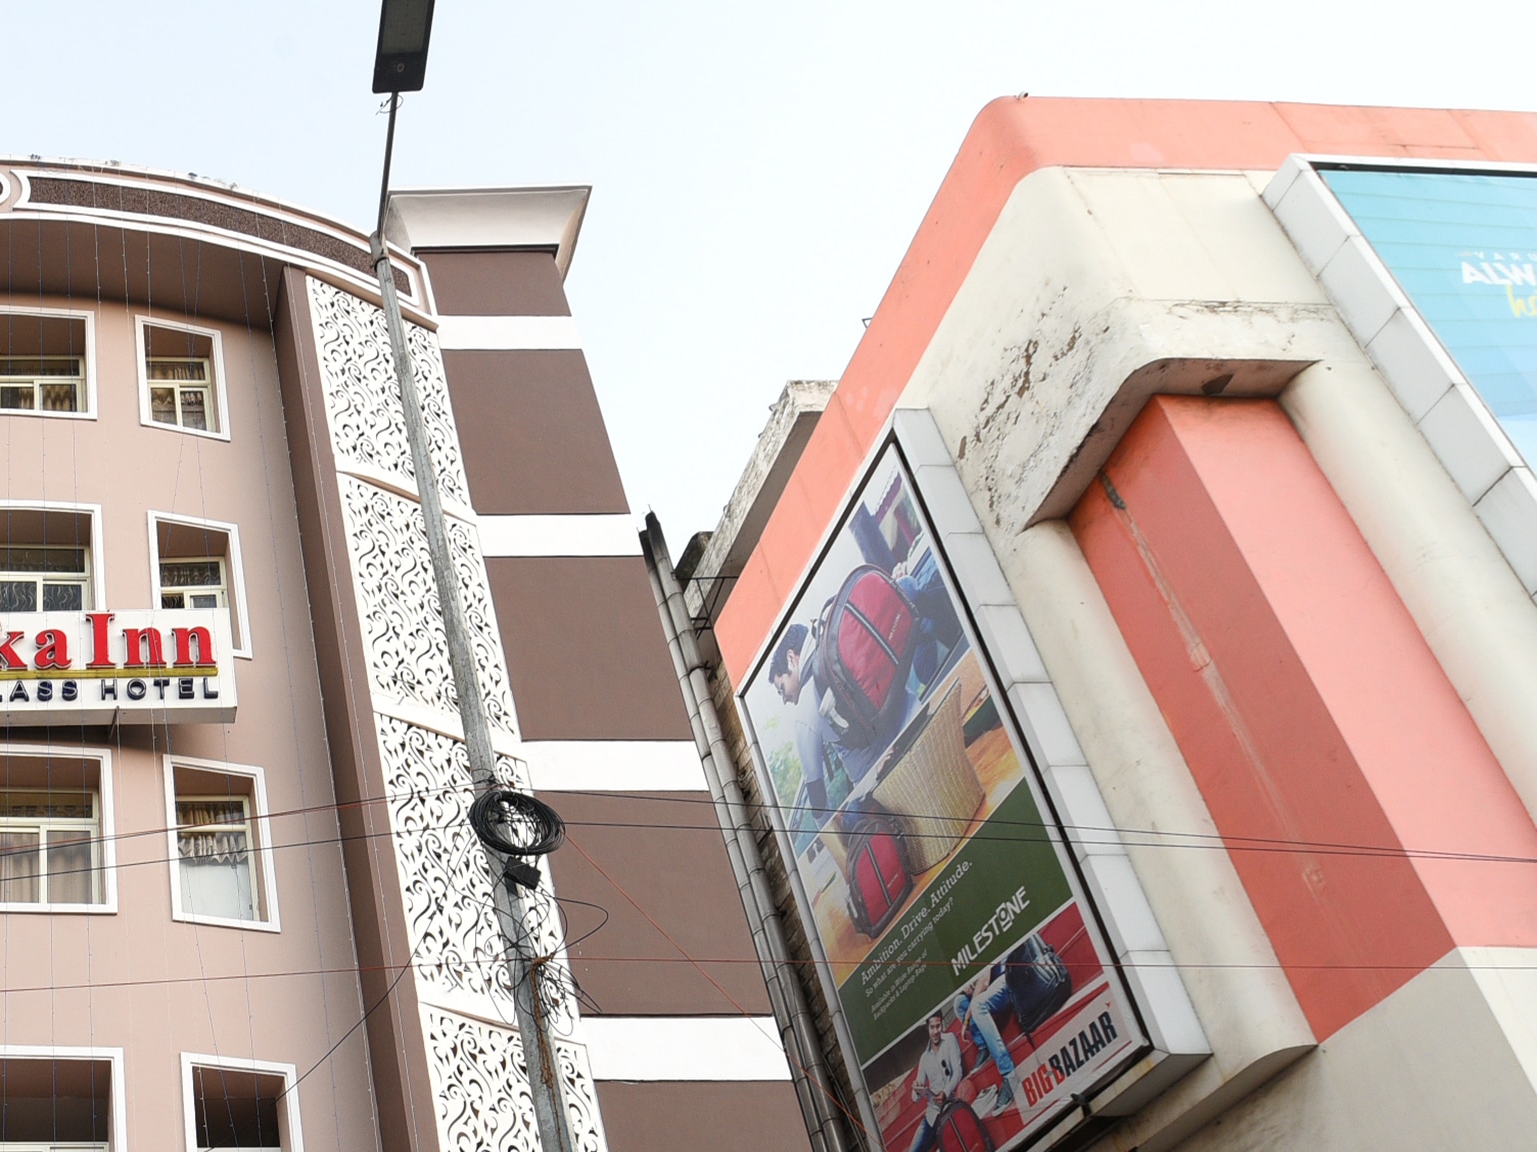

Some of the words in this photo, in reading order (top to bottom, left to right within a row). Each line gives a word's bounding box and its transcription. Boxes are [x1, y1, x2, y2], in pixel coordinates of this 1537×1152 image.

[85, 613, 217, 668] Inn
[100, 677, 219, 701] HOTEL
[861, 938, 903, 986] Ambition.
[901, 907, 931, 940] Drive.
[929, 860, 973, 909] Attitude.
[907, 921, 934, 952] carrying
[932, 896, 954, 924] today?
[951, 886, 1030, 976] MILESTONE
[1021, 1063, 1054, 1108] BIG
[1048, 1011, 1118, 1086] BAZAAR
